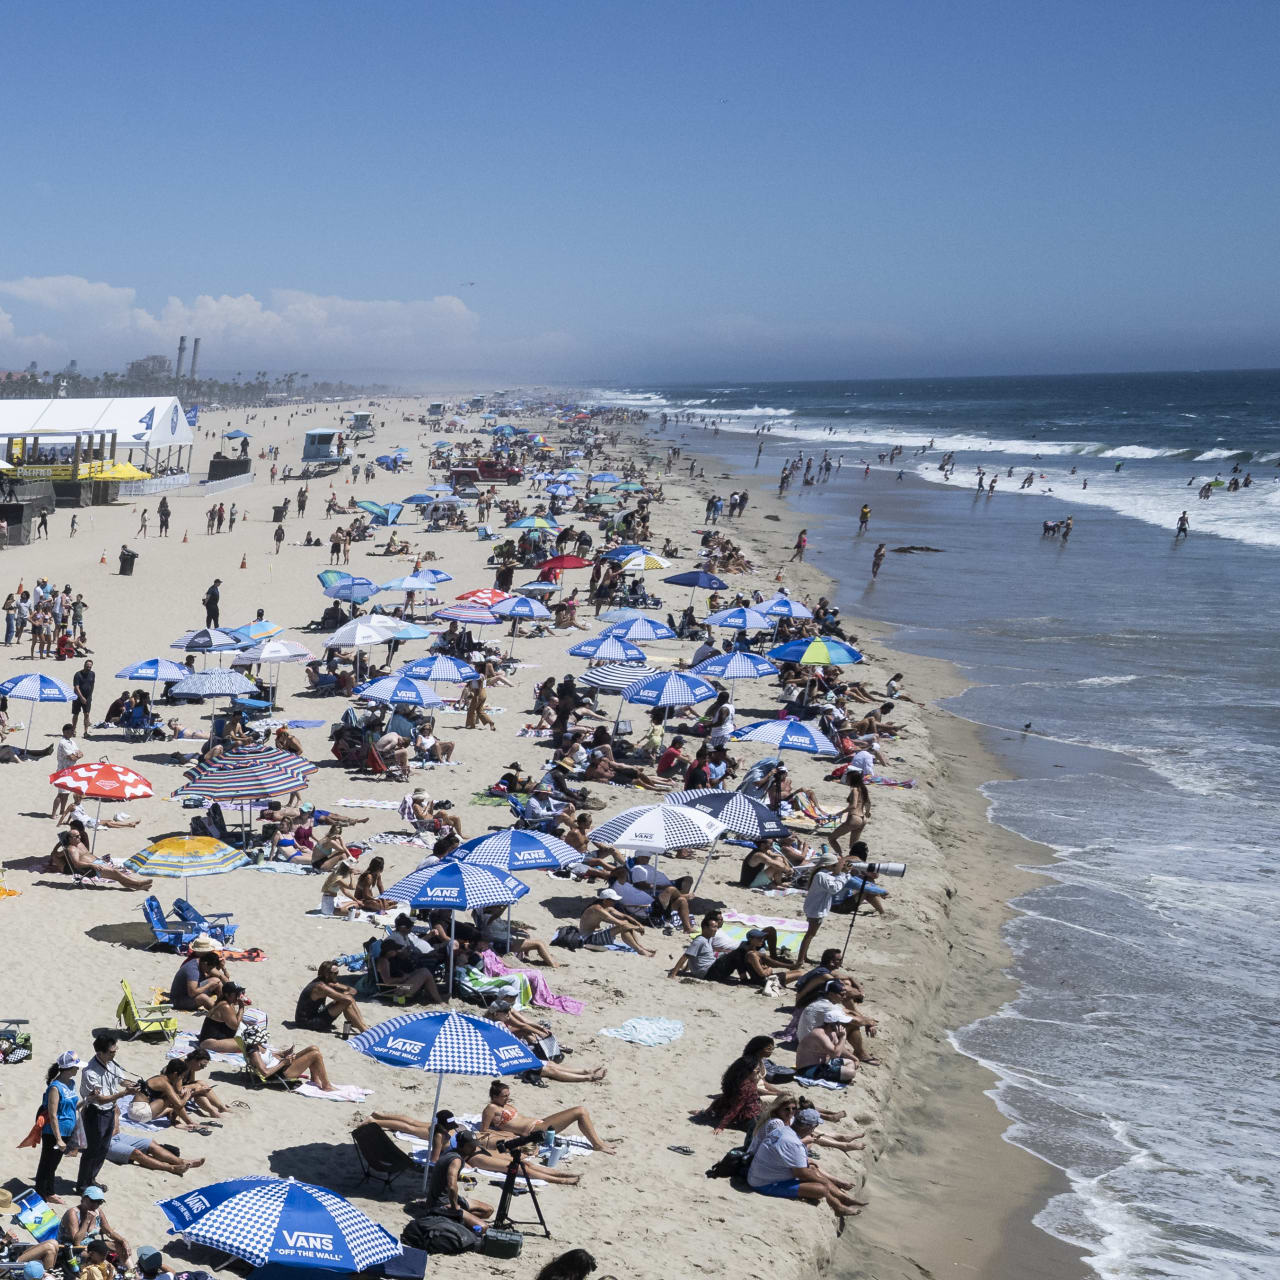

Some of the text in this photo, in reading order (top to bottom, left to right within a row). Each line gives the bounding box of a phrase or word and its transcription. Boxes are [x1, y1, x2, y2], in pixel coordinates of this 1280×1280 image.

[634, 832, 654, 840] VANS
[514, 850, 547, 862] VANS
[426, 887, 461, 897] VANS
[386, 1036, 426, 1054] VANS
[493, 1045, 525, 1061] VANS
[183, 1191, 211, 1215] VANS
[282, 1230, 334, 1251] VANS
[274, 1248, 344, 1262] "OFF THE WALL"
